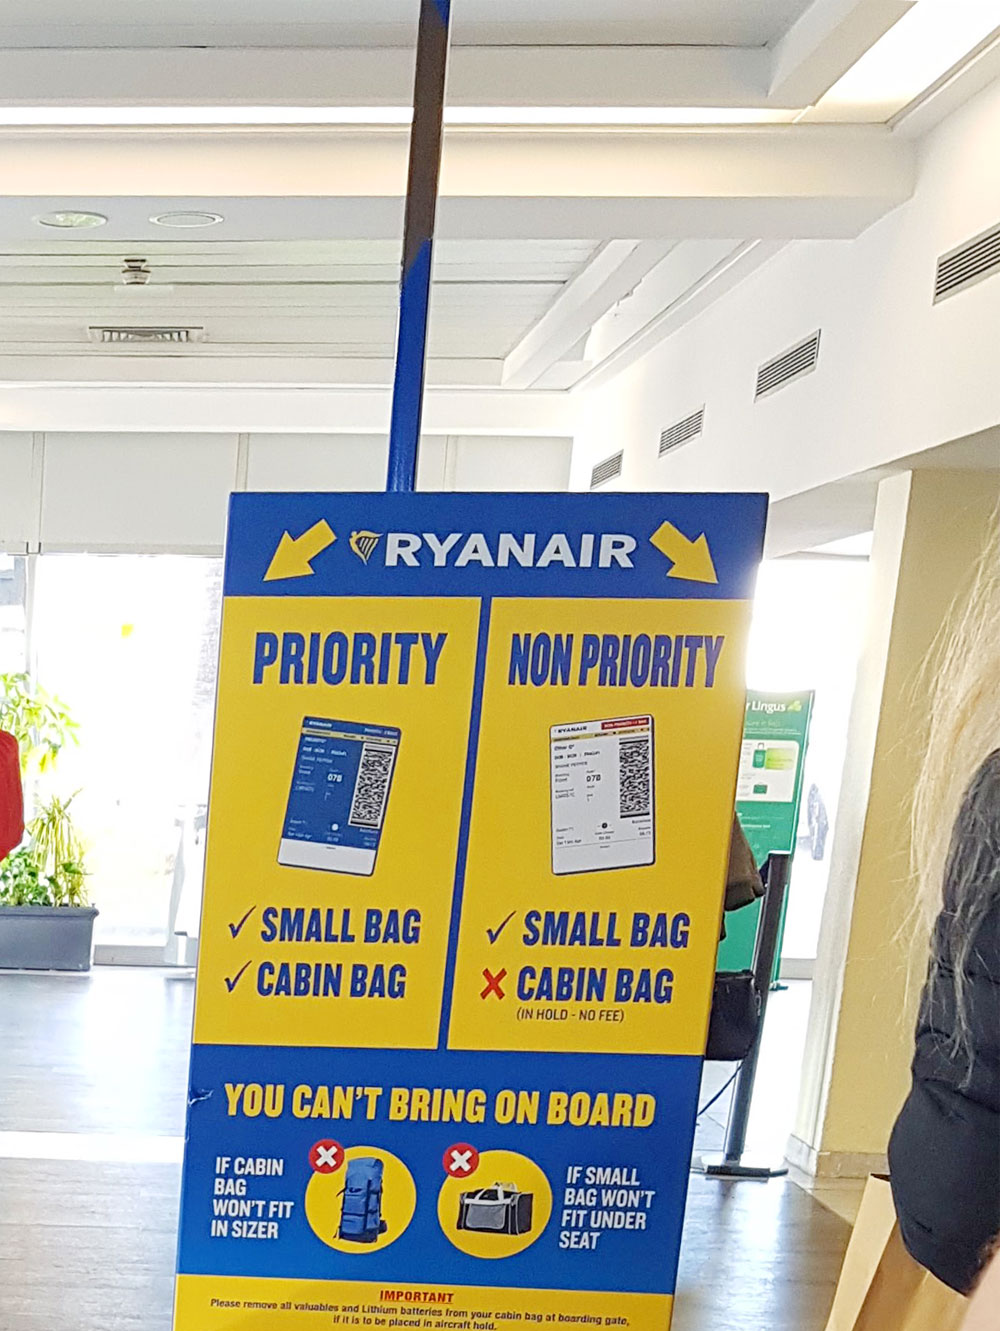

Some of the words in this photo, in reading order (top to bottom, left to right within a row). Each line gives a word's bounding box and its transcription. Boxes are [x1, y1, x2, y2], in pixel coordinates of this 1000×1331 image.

[385, 532, 637, 568] RYANAIR
[253, 631, 448, 685] PRIORITY
[508, 632, 574, 687] NON
[578, 632, 725, 688] PRIORITY
[752, 700, 786, 714] Lingus
[260, 906, 355, 943] SMALL
[364, 908, 422, 944] BAG
[522, 909, 621, 947] SMALL
[630, 912, 690, 949] BAG
[257, 961, 343, 997] CABIN
[350, 963, 407, 999] BAG
[516, 965, 607, 1002] CABIN
[614, 967, 674, 1004] BAG
[516, 1006, 533, 1021] (IN
[536, 1007, 568, 1021] HOLD
[579, 1009, 596, 1021] NO
[599, 1008, 625, 1023] FEE)
[224, 1083, 285, 1118] YOU
[292, 1084, 383, 1120] CAN'T
[389, 1087, 487, 1123] BRING
[494, 1089, 540, 1125] ON
[546, 1091, 656, 1128] BOARD
[215, 1156, 231, 1175] IF
[234, 1157, 284, 1176] CABIN
[566, 1166, 582, 1184] IF
[585, 1167, 640, 1186] SMALL
[214, 1178, 247, 1196] BAG
[564, 1188, 597, 1207] BAG
[598, 1190, 655, 1208] WON'T
[212, 1199, 266, 1218] WON'T
[268, 1201, 294, 1218] FIT
[561, 1209, 590, 1228] FIT
[590, 1210, 646, 1229] UNDER
[210, 1220, 229, 1238] IN
[231, 1220, 279, 1239] SIZER
[558, 1231, 600, 1250] SEAT
[380, 1289, 454, 1303] IMPORTANT
[210, 1298, 241, 1308] Please
[243, 1301, 278, 1310] remove
[280, 1301, 292, 1310] all
[294, 1302, 339, 1312] valuables
[341, 1304, 359, 1313] and
[361, 1305, 398, 1315] Lithium
[400, 1306, 443, 1317] batteries
[445, 1308, 468, 1318] from
[470, 1310, 492, 1321] your
[494, 1311, 522, 1321] cabin
[524, 1312, 543, 1323] bag
[545, 1313, 556, 1322] at
[558, 1313, 602, 1326] boarding
[604, 1316, 630, 1327] gate,
[333, 1314, 340, 1324] if
[342, 1315, 349, 1324] it
[351, 1315, 360, 1325] is
[362, 1316, 372, 1326] to
[374, 1316, 386, 1326] be
[388, 1317, 421, 1328] placed
[423, 1318, 433, 1328] in
[434, 1318, 471, 1330] aircraft
[473, 1320, 498, 1331] hold.
